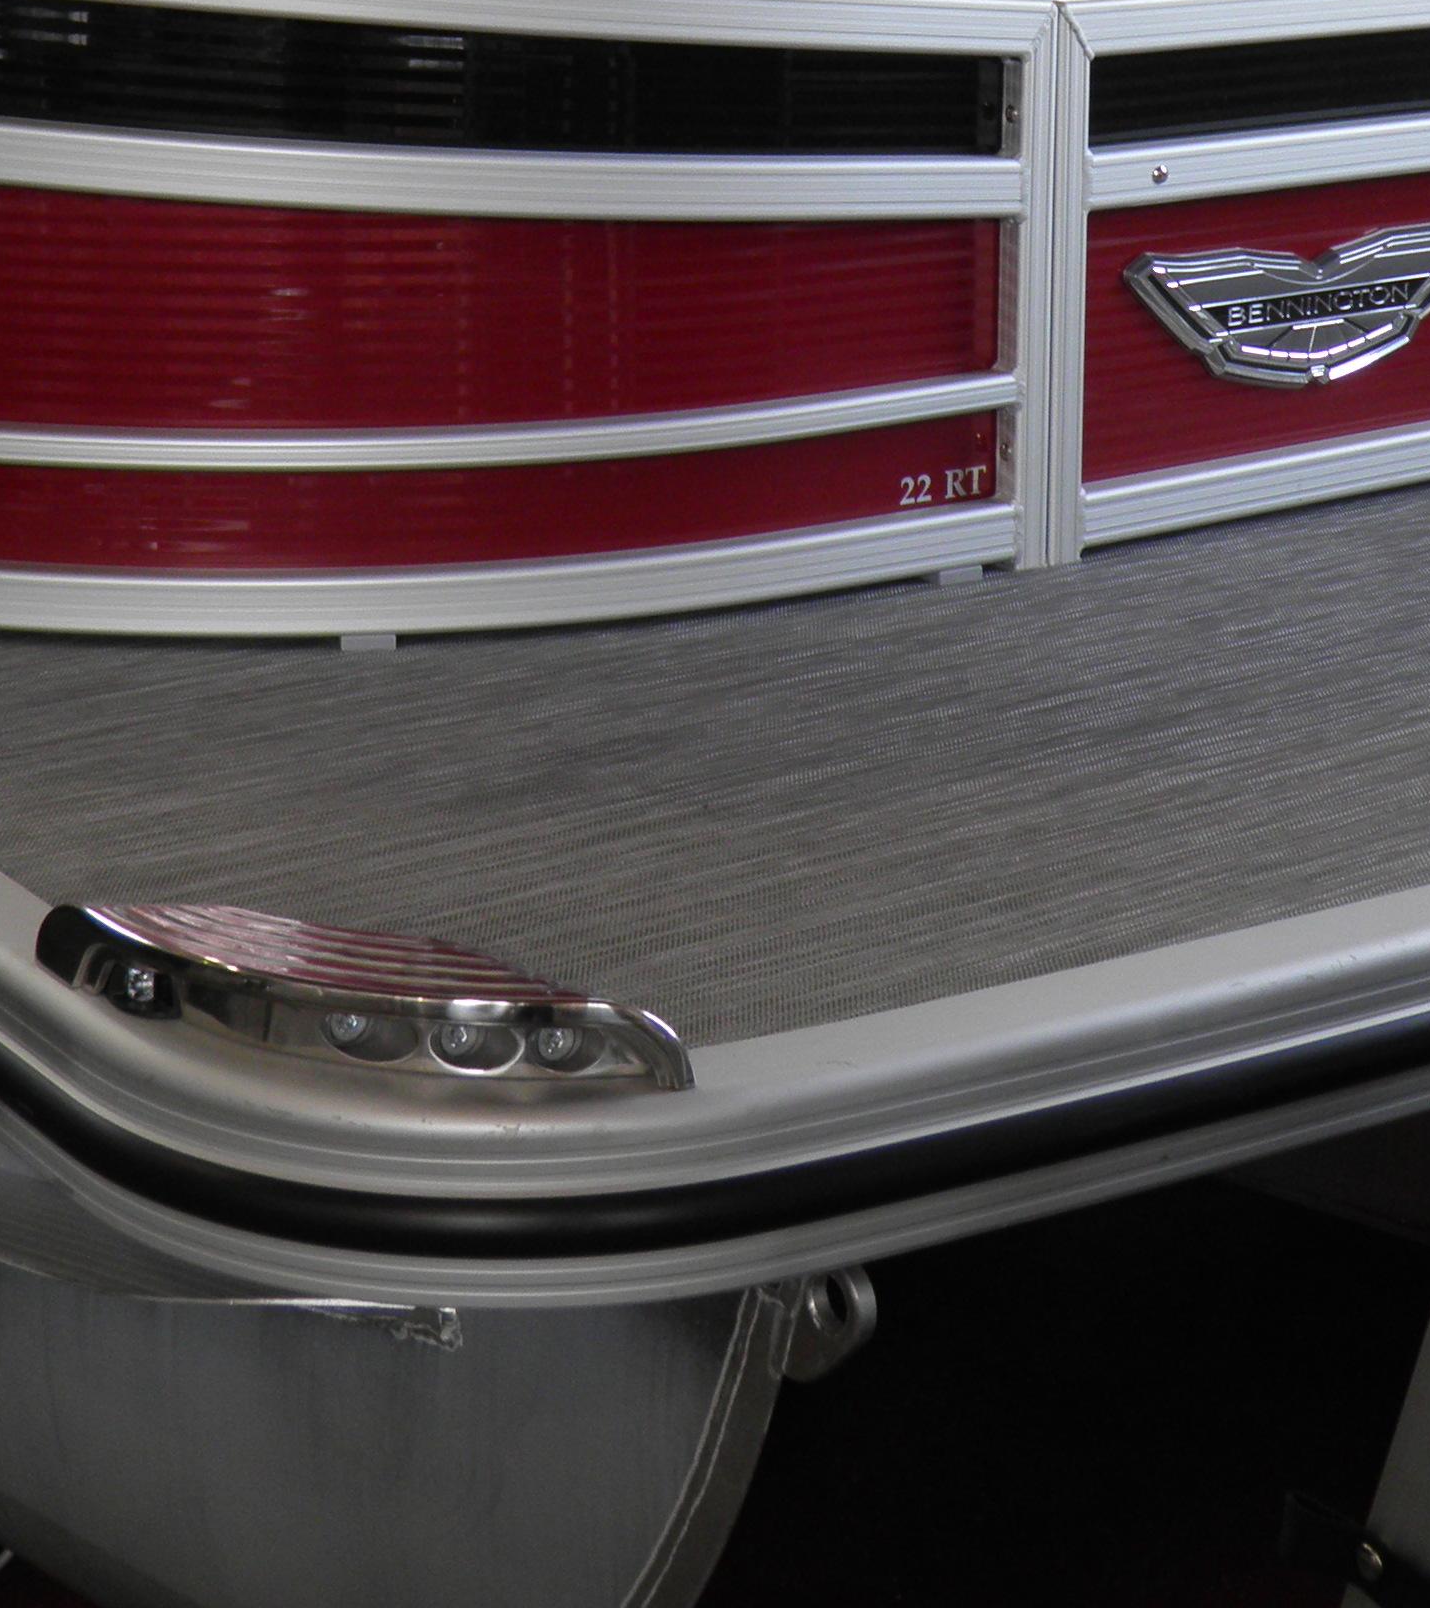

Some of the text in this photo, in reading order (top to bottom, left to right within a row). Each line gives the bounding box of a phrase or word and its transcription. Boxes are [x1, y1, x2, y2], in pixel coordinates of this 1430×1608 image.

[1227, 283, 1410, 327] BENNINGTON
[900, 465, 987, 506] 22 RT
